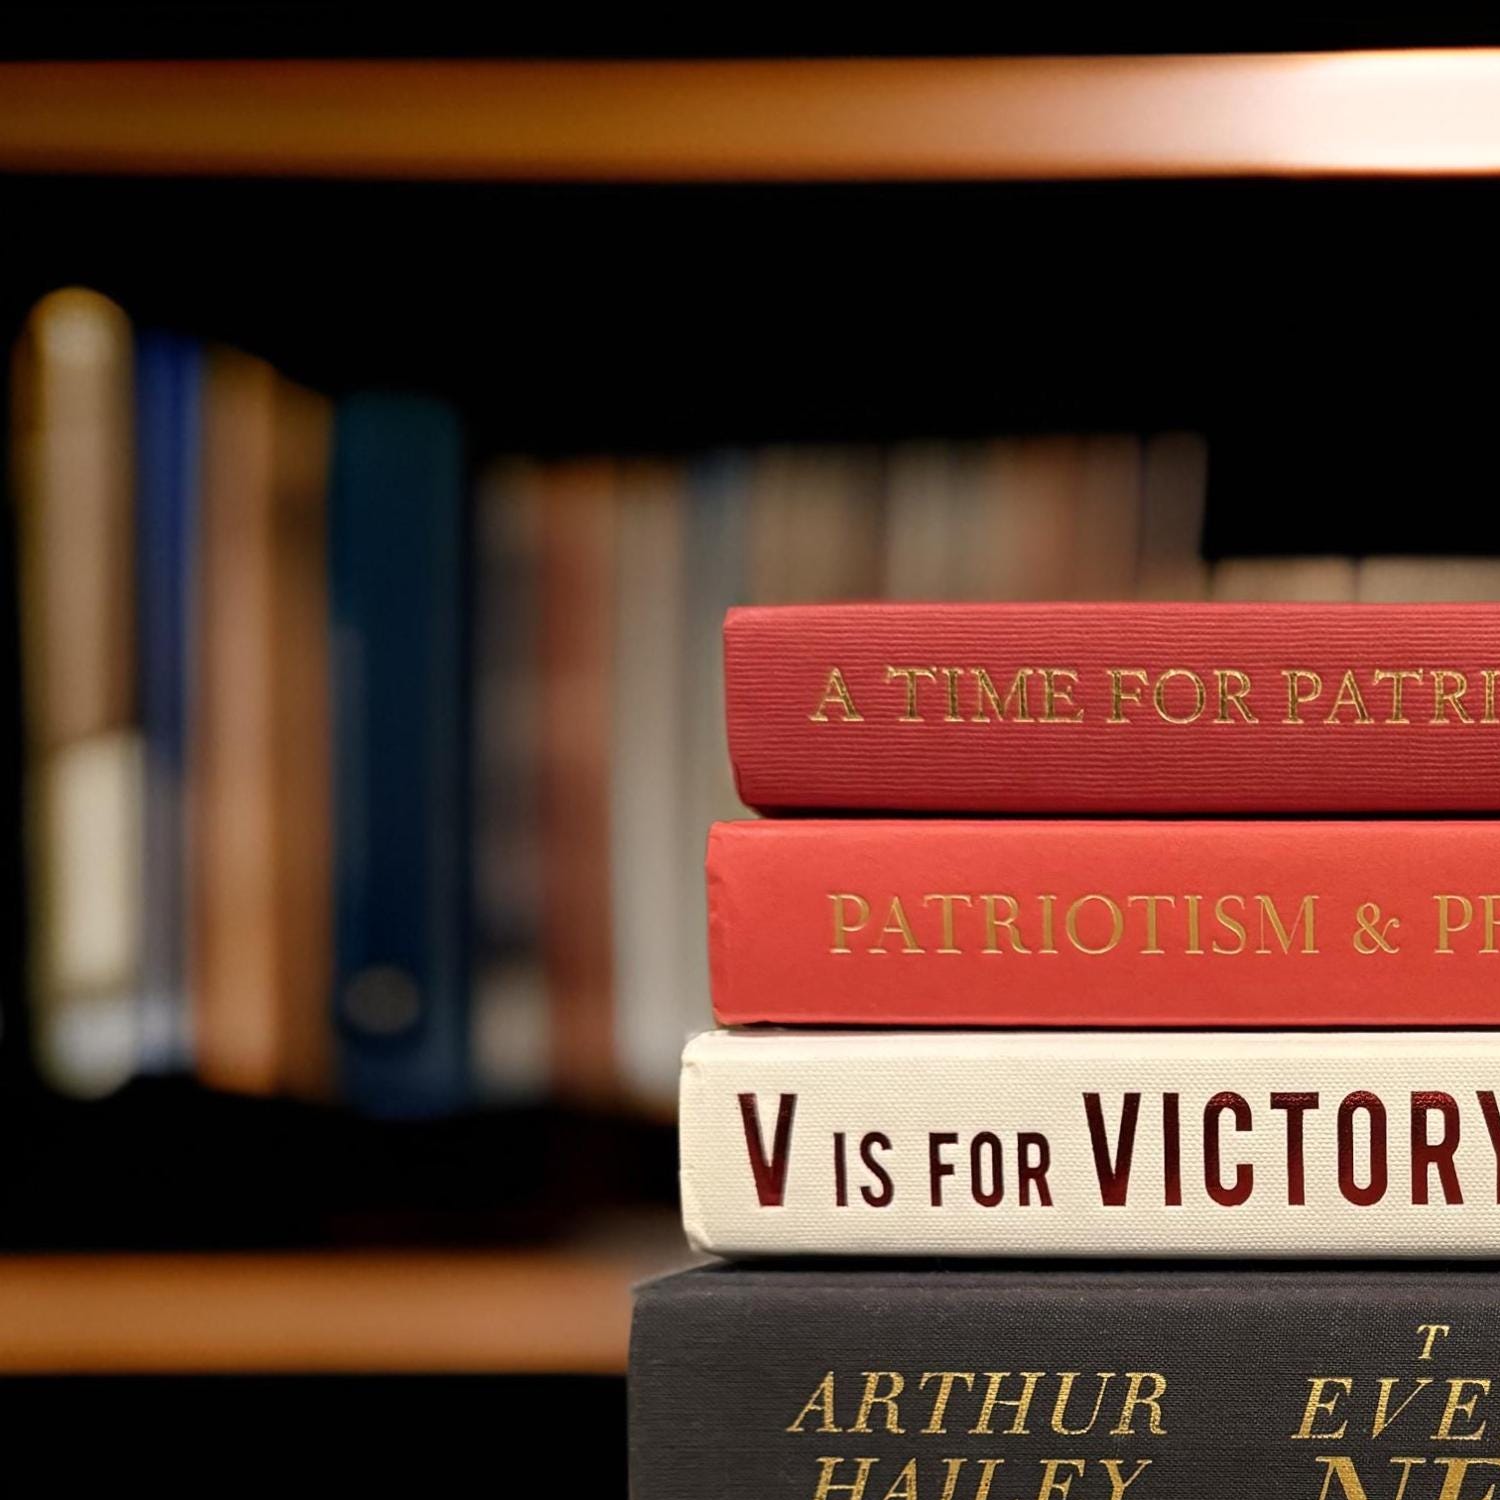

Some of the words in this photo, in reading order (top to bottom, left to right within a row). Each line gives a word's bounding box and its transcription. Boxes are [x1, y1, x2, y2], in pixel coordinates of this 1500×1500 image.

[809, 668, 864, 723] A
[884, 667, 1085, 725] TIME
[1106, 668, 1256, 726] FOR
[827, 892, 1320, 956] PATRIOTISM
[1353, 901, 1401, 955] &
[737, 1092, 799, 1208] V
[833, 1131, 895, 1209] IS
[930, 1131, 1054, 1209] FOR
[786, 1370, 1169, 1436] ARTHUR
